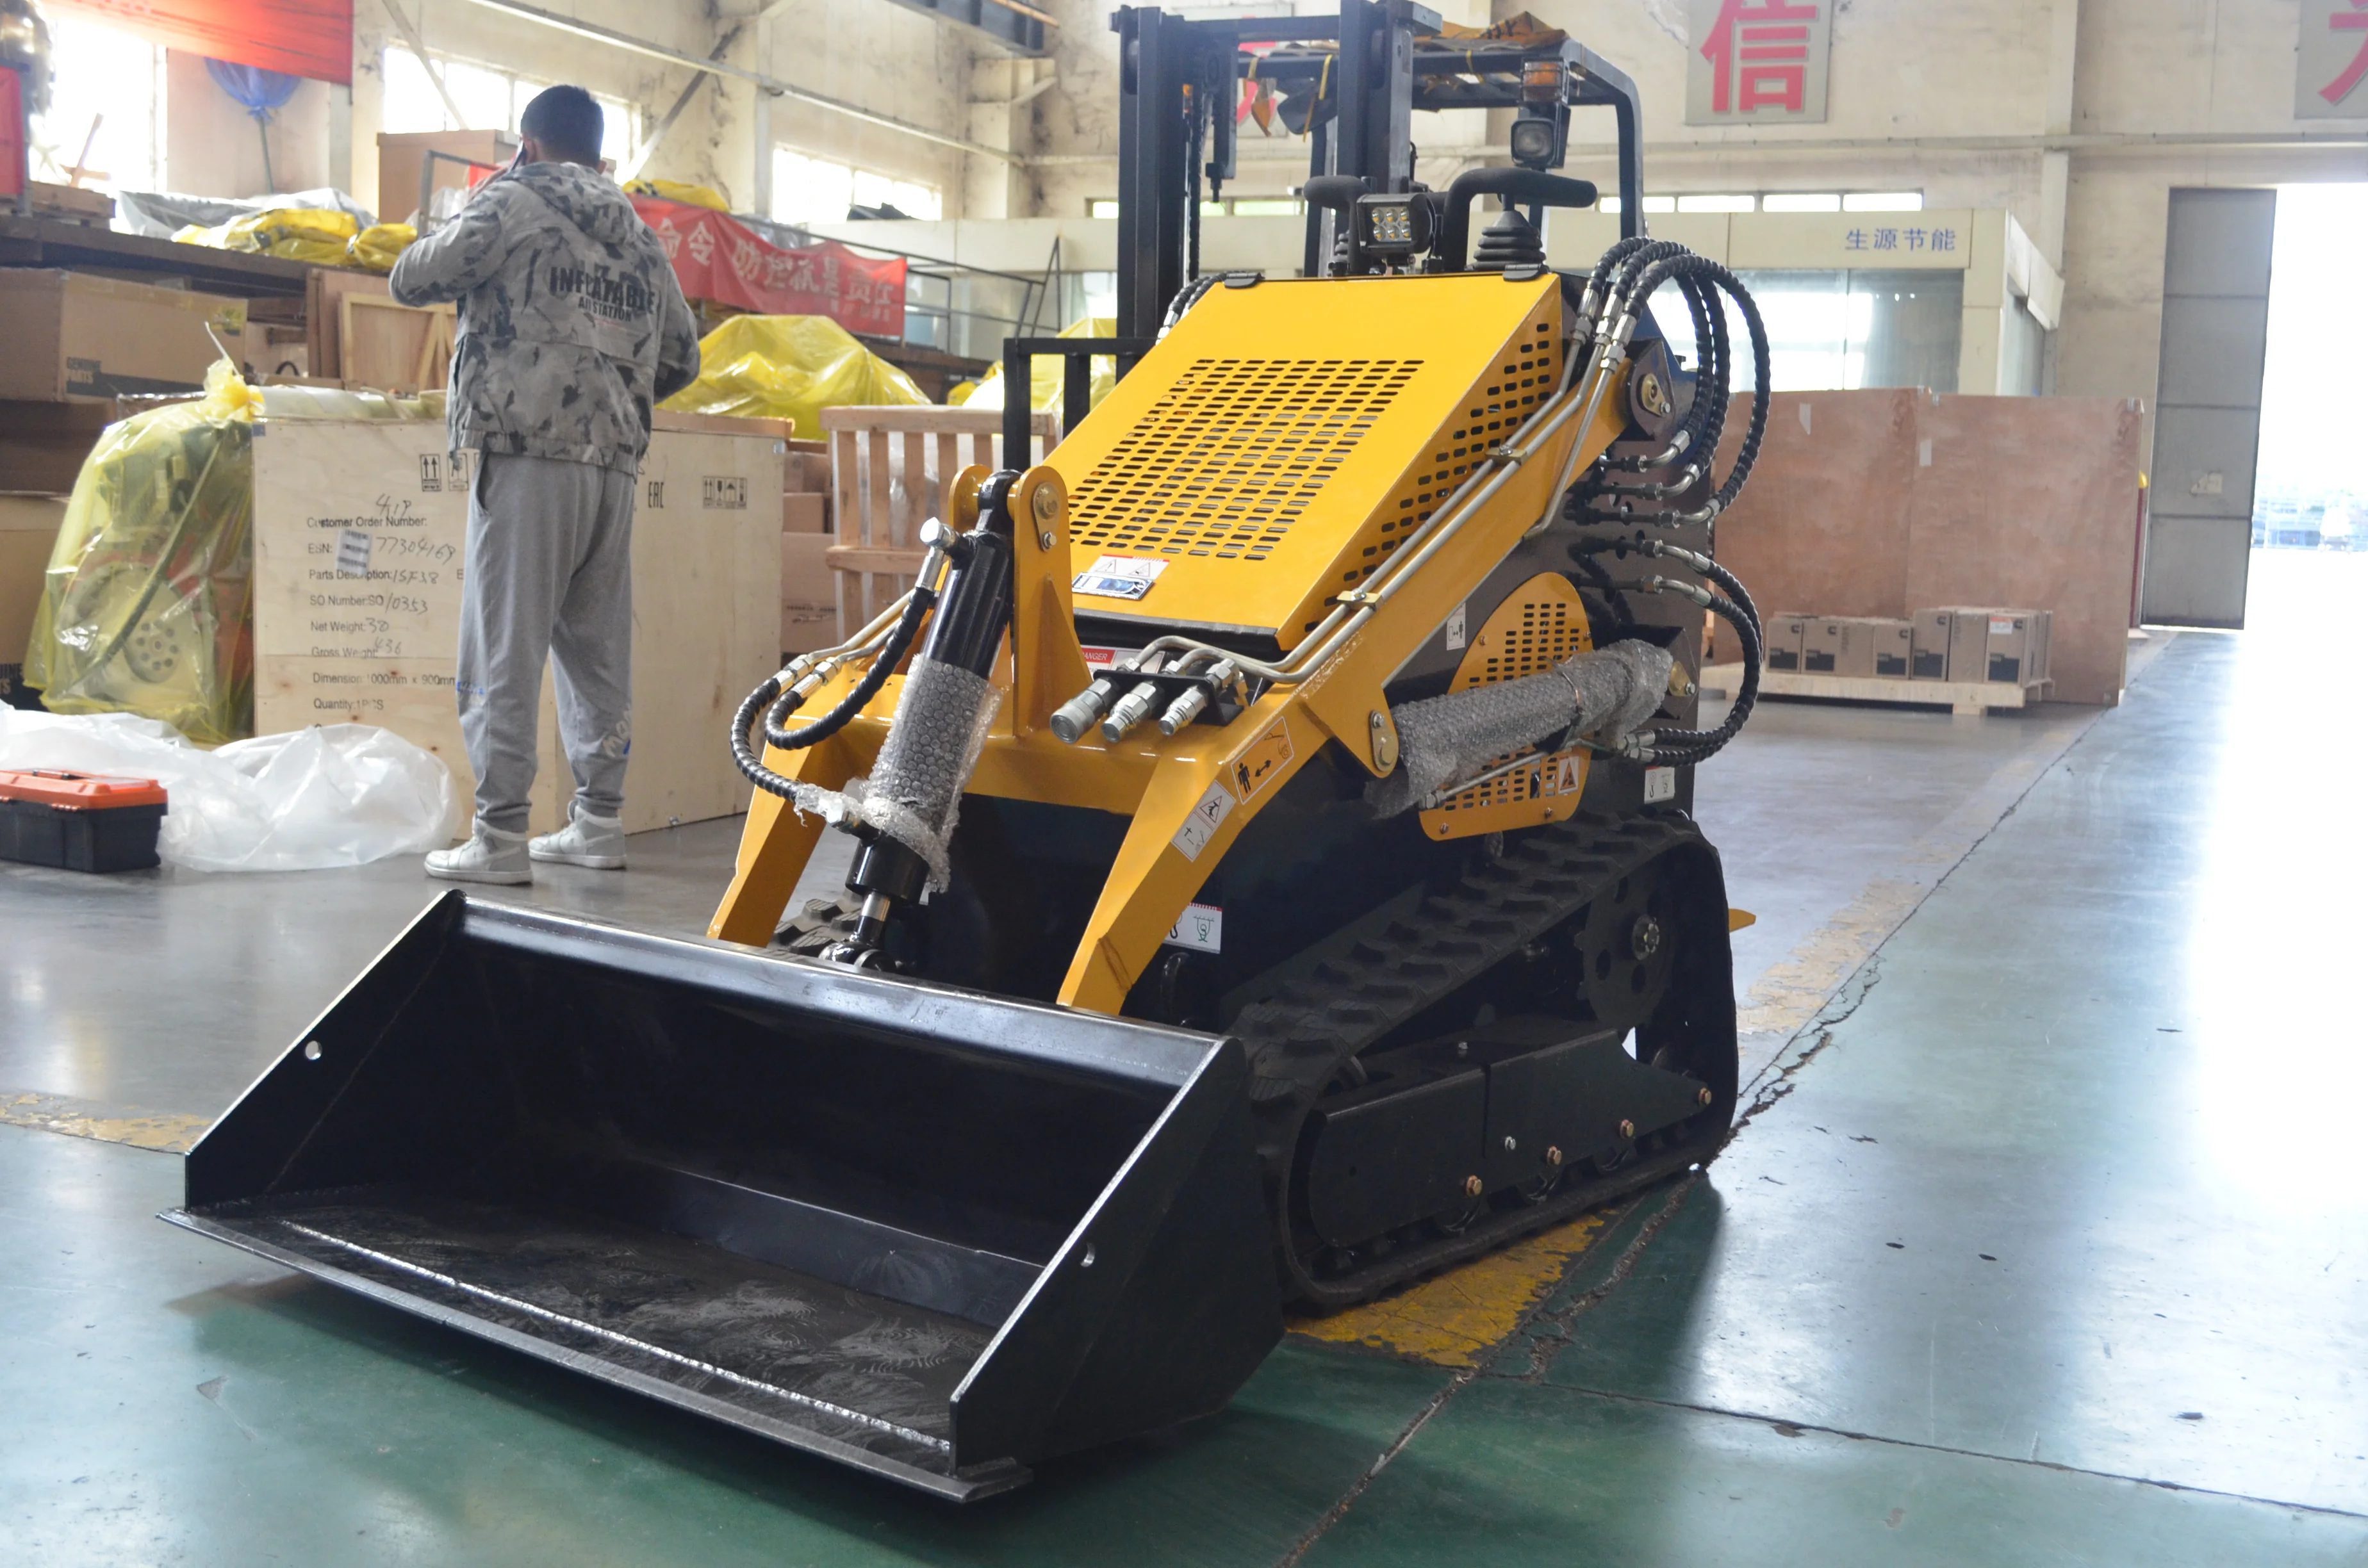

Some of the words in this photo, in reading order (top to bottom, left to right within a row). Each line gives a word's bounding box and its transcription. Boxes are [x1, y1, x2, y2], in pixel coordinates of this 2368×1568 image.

[1700, 0, 1817, 111] 信
[1845, 227, 1956, 250] 生源节能
[593, 301, 632, 322] STATION
[307, 516, 352, 528] Customer
[356, 516, 383, 527] Order
[386, 516, 427, 527] Number:
[308, 543, 333, 554] ESN:
[309, 569, 333, 580] Parts
[309, 594, 325, 606] SO
[311, 620, 327, 632] Net
[311, 646, 340, 658] Gross
[1083, 651, 1108, 661] ANGER
